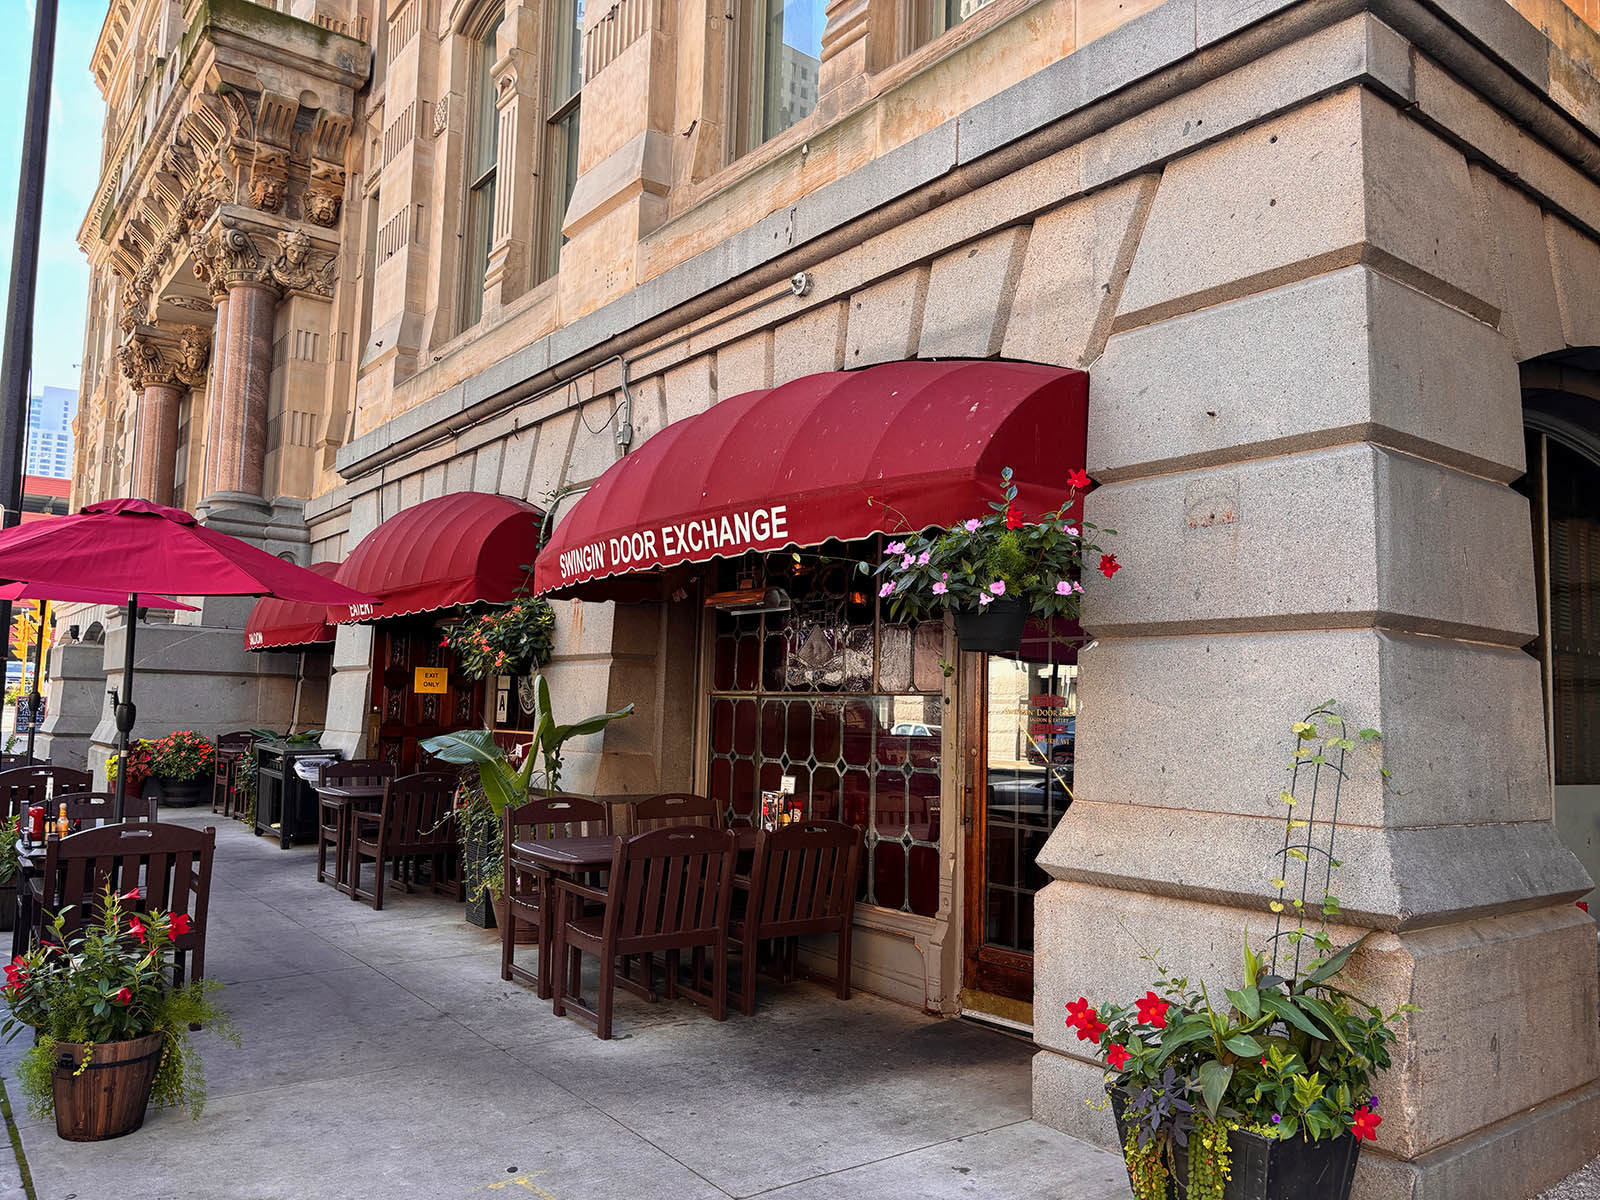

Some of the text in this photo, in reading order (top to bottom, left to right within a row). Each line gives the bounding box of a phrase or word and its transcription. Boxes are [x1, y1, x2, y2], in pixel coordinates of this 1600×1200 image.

[560, 505, 789, 578] SWINGIN' DOOR EXCHANGE
[499, 695, 506, 711] A
